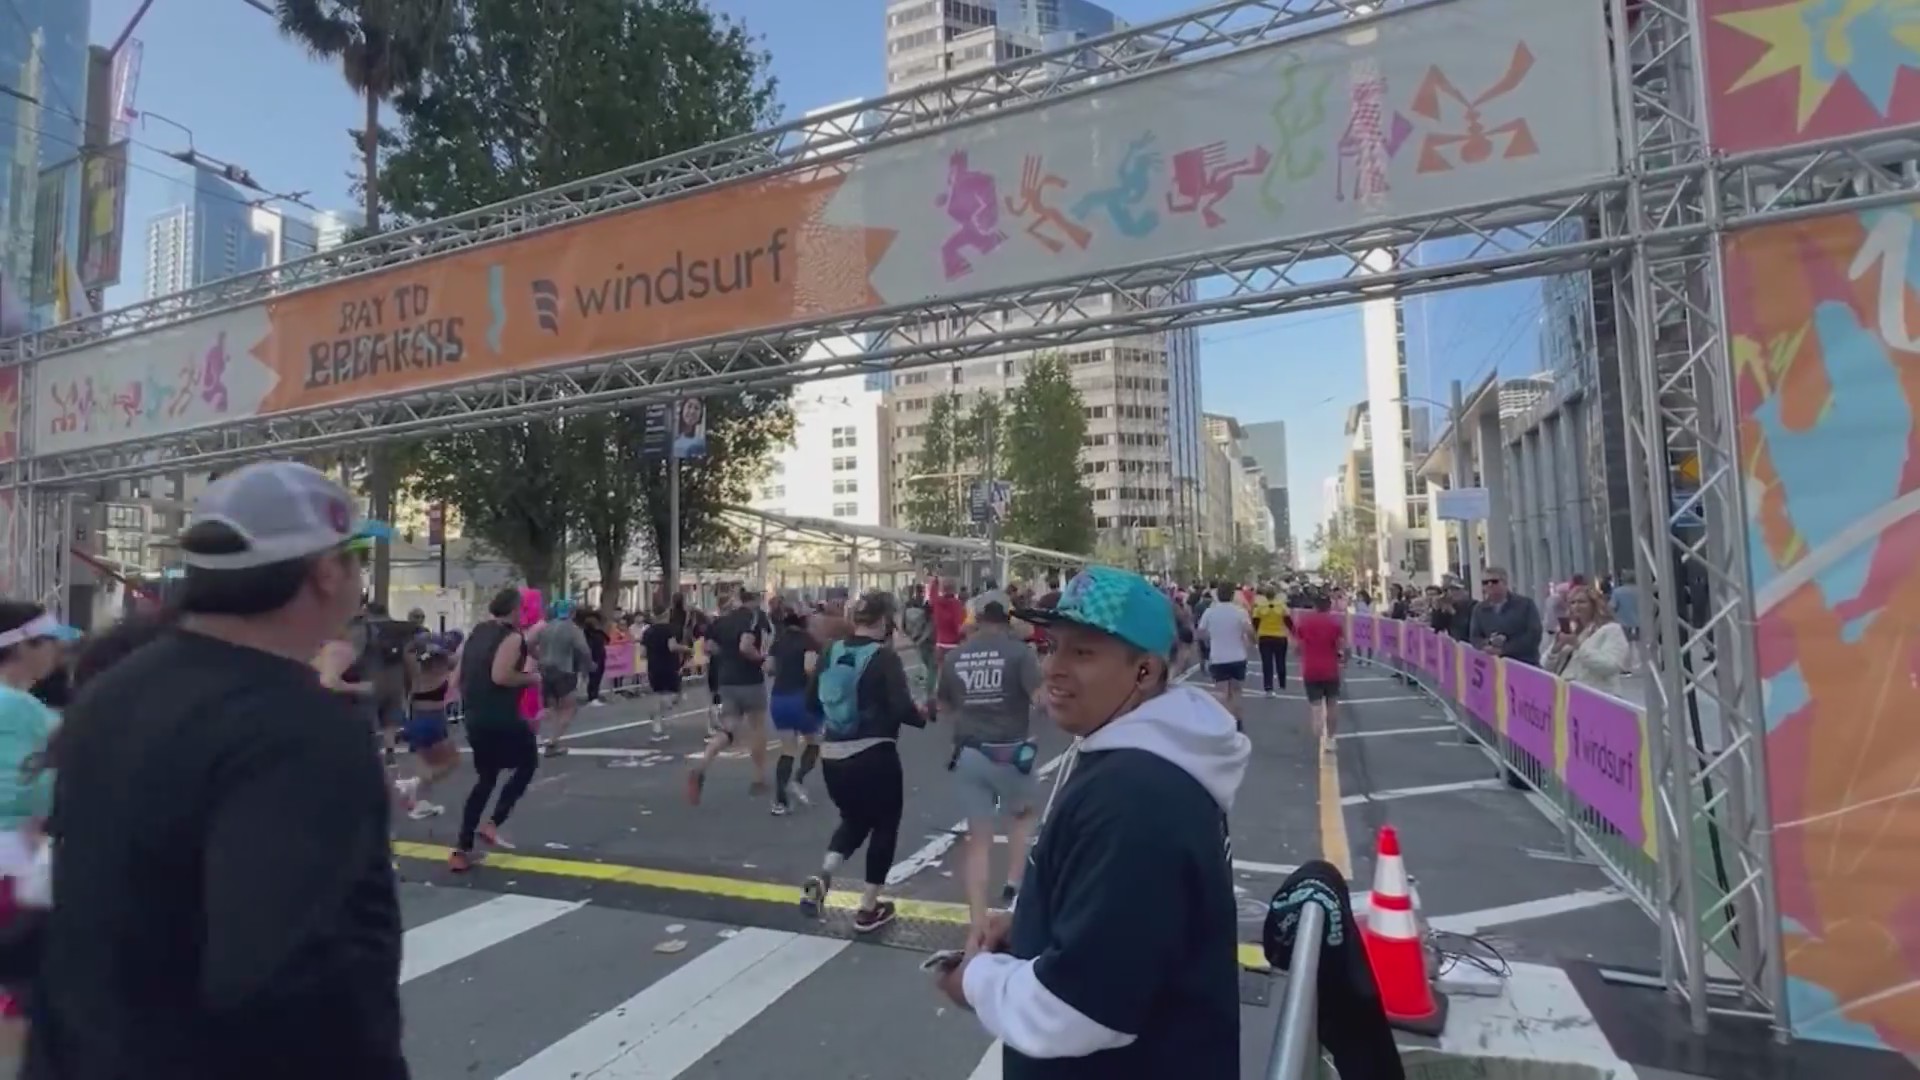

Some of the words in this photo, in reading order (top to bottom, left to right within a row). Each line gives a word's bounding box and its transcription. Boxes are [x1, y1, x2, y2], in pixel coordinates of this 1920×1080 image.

[574, 227, 788, 318] windsurf
[339, 297, 385, 334] BAY
[395, 283, 429, 321] TO
[304, 317, 464, 391] BREAKERS
[957, 669, 1002, 690] VOLO
[1582, 729, 1633, 793] windsurf
